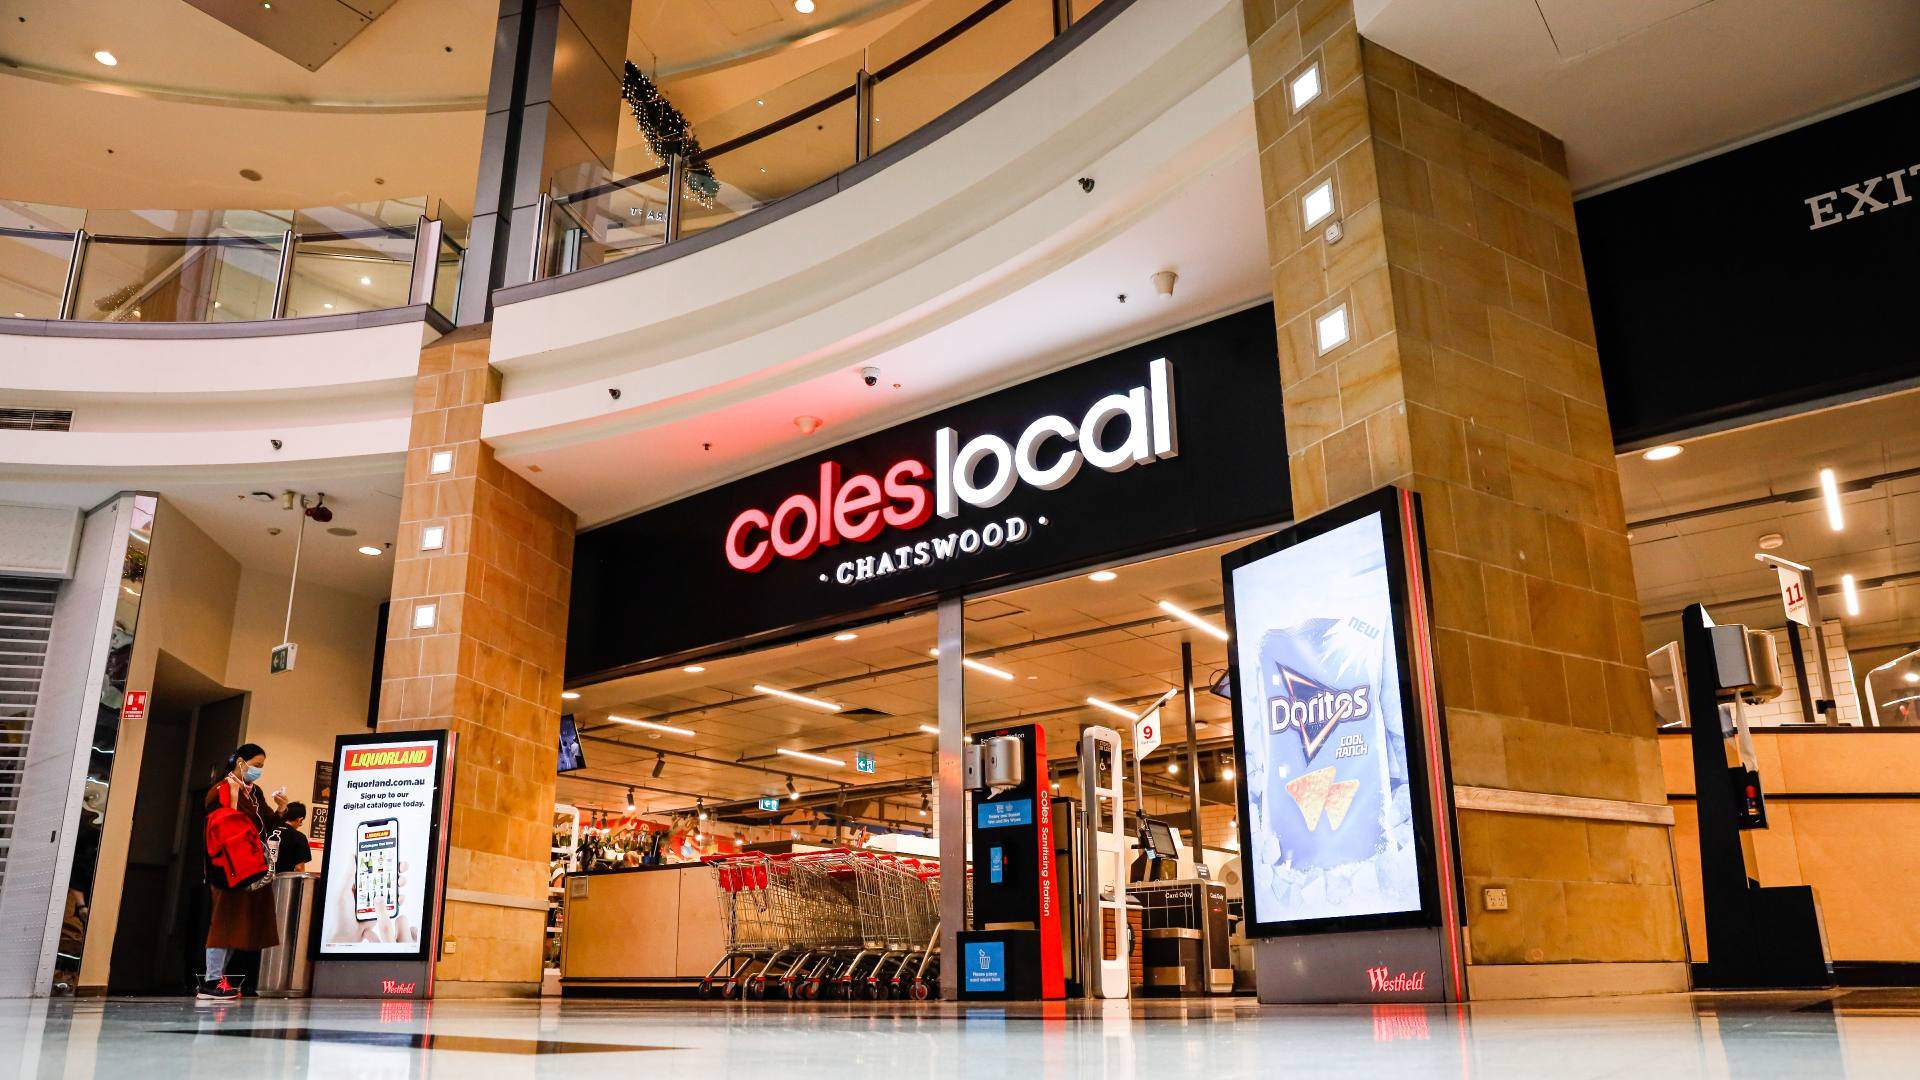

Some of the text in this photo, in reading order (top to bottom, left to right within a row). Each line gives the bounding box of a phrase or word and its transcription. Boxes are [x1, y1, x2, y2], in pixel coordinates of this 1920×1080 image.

[725, 356, 1179, 573] coles local
[836, 516, 1030, 585] CHATSWOOD
[1785, 583, 1804, 605] 11
[1269, 685, 1370, 735] Doritos
[1143, 725, 1153, 739] 9
[1340, 734, 1365, 746] COOL
[351, 750, 427, 768] LIQUORLAND
[1335, 745, 1369, 759] RANCH
[347, 779, 425, 789] liquorland.com.au
[360, 792, 376, 801] Sign
[388, 791, 396, 799] to
[343, 800, 425, 811] digital catalogue today.
[1041, 790, 1049, 824] coles
[1041, 827, 1049, 877] Sanitising
[1179, 891, 1193, 899] Only
[381, 979, 416, 995] Westfield
[1366, 966, 1426, 992] Westfield
